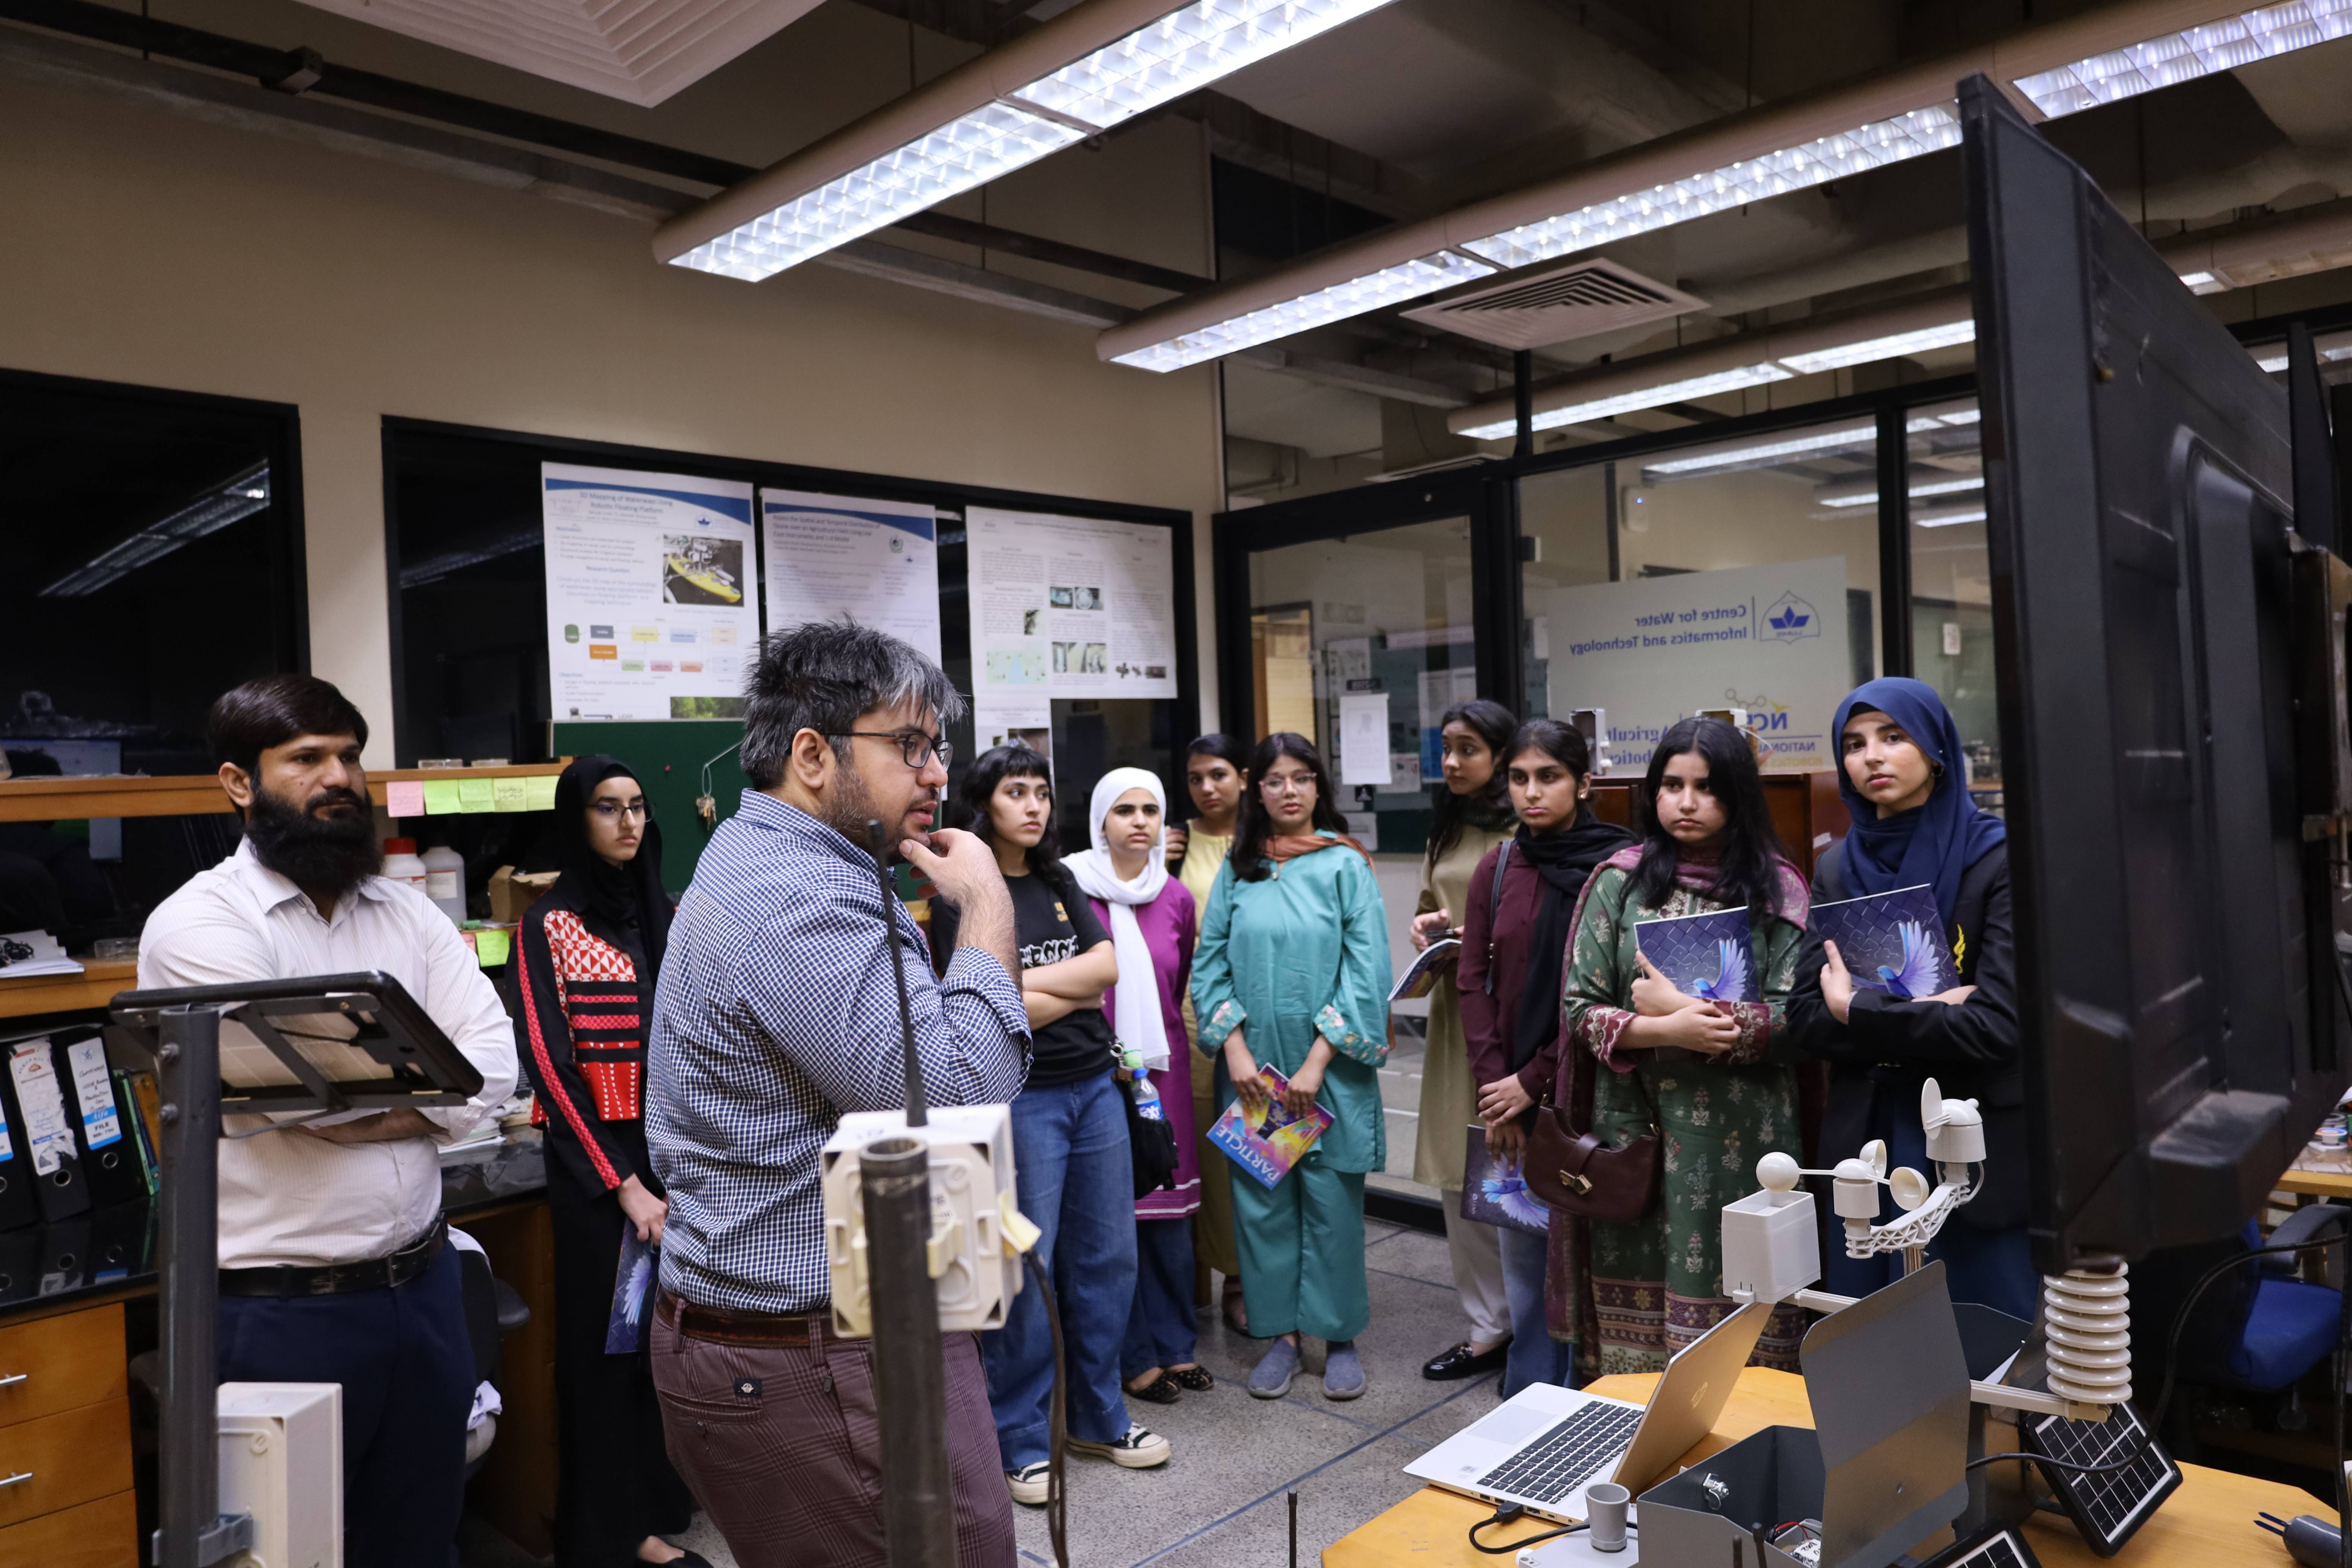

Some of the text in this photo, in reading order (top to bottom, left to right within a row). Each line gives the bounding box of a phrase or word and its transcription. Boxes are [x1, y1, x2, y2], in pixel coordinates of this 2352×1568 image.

[590, 493, 615, 502] Mapping
[94, 1121, 110, 1131] FILE
[1215, 1124, 1280, 1181] PARTICLE
